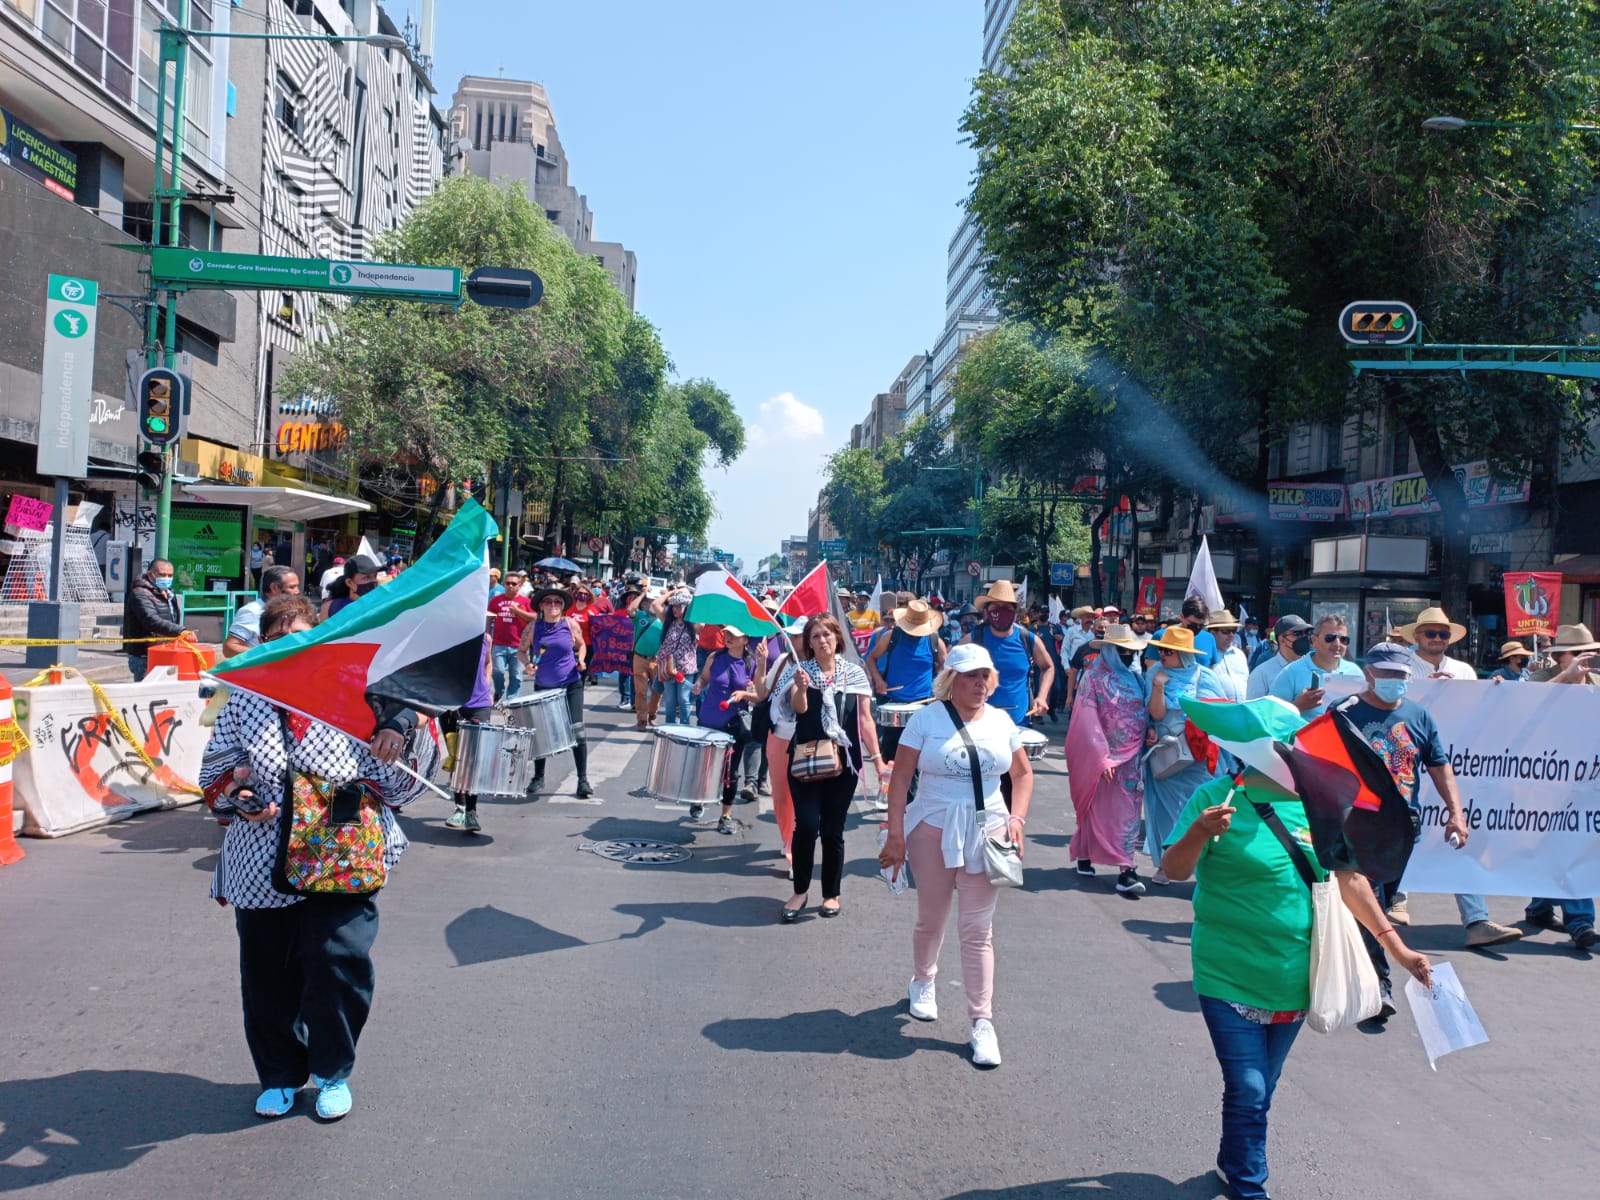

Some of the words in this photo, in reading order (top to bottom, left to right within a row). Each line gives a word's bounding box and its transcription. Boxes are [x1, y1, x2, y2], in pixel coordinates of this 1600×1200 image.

[11, 124, 77, 174] LICENCIATURAS
[22, 146, 29, 160] &
[30, 151, 77, 188] MAESTRÍAS
[206, 262, 236, 270] Corredor
[357, 271, 415, 282] Independencia
[56, 351, 75, 449] Independencia
[1574, 759, 1588, 782] a
[1486, 802, 1579, 833] autonomía
